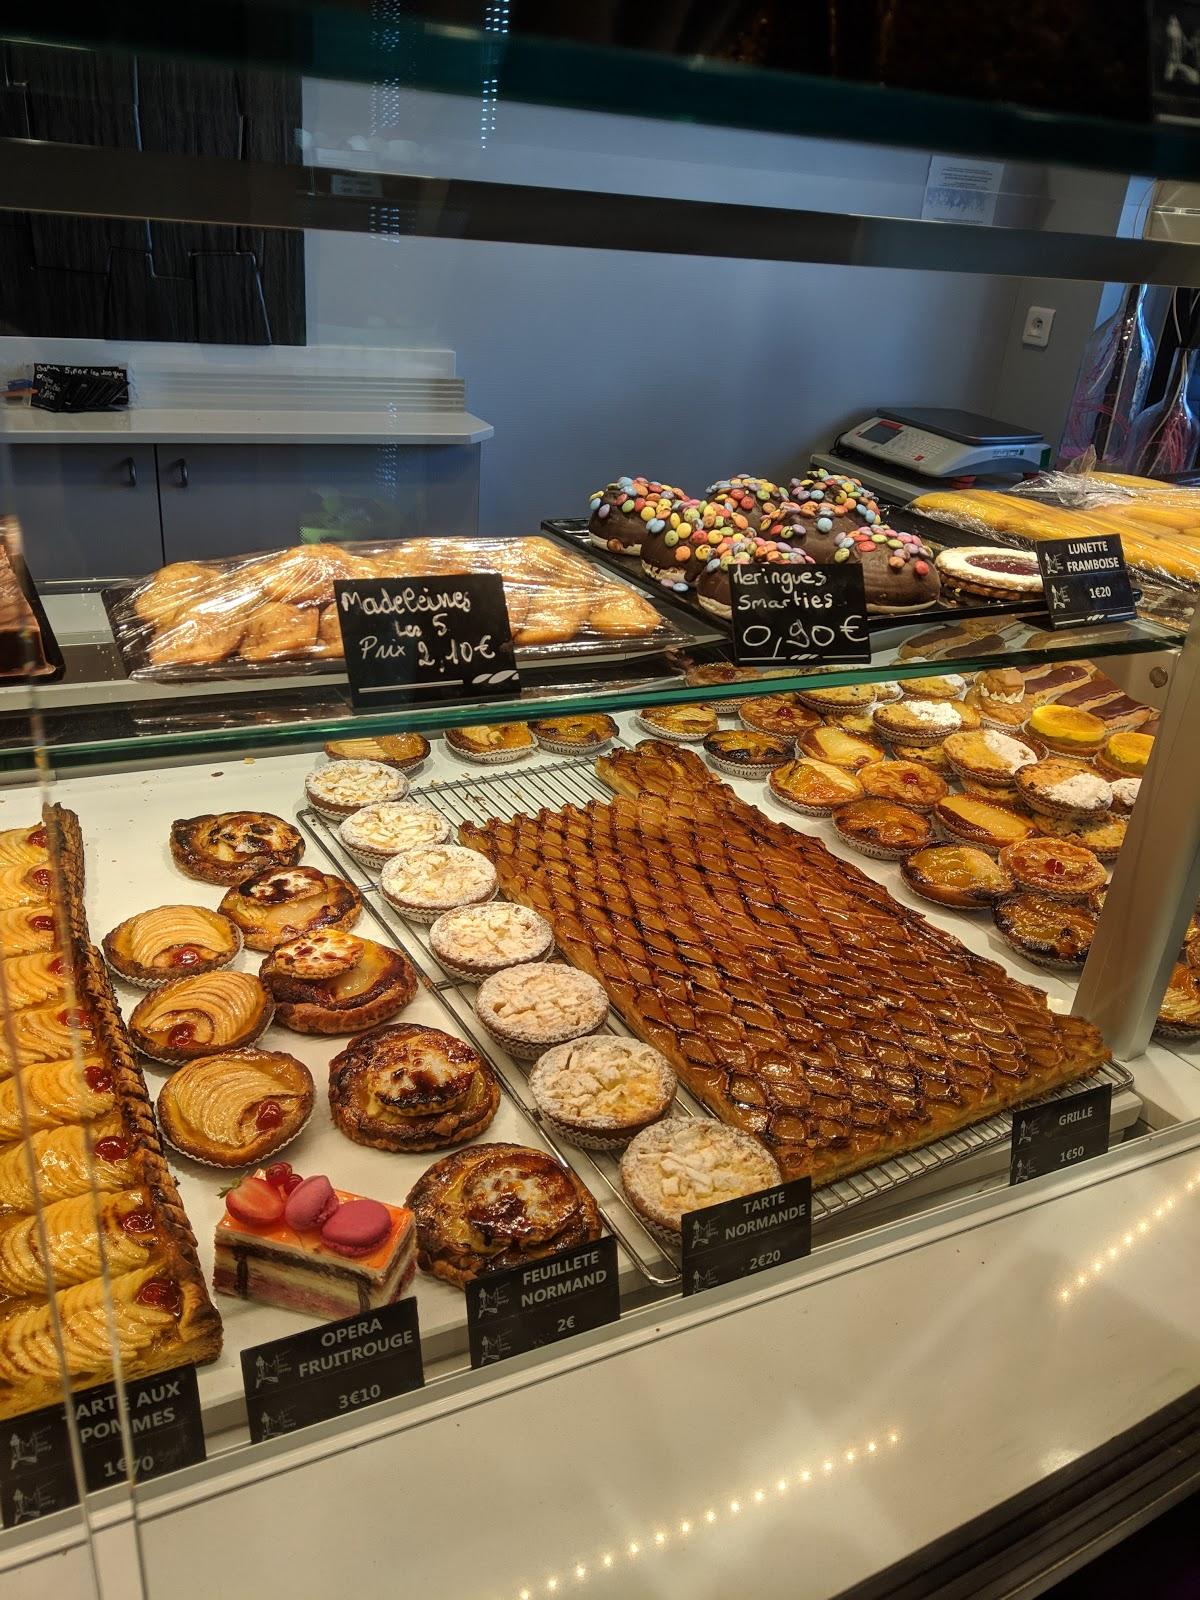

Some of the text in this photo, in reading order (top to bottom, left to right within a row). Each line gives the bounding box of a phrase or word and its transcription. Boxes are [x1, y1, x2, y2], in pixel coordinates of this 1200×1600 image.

[1067, 541, 1109, 555] LUNETTE
[1066, 557, 1120, 573] FRAMBOISE
[341, 587, 471, 615] Madeleines
[737, 590, 833, 611] Smarties
[1089, 586, 1112, 599] 1€20
[432, 612, 448, 637] 5
[743, 615, 869, 658] 0,90€
[359, 635, 406, 660] Prix
[1058, 1106, 1093, 1126] GRILLE
[1060, 1146, 1084, 1163] 1€50
[743, 1191, 785, 1215] TARTE
[725, 1203, 807, 1240] NORMANDE
[523, 1250, 599, 1286] FEUILLETE
[749, 1250, 781, 1270] 2€20
[521, 1269, 607, 1308] NORMAND
[321, 1318, 383, 1347] OPERA
[557, 1315, 576, 1332] 2€
[298, 1330, 414, 1378] FRUITROUGE
[64, 1381, 181, 1421] ARTE AUX
[338, 1384, 381, 1410] 3€10
